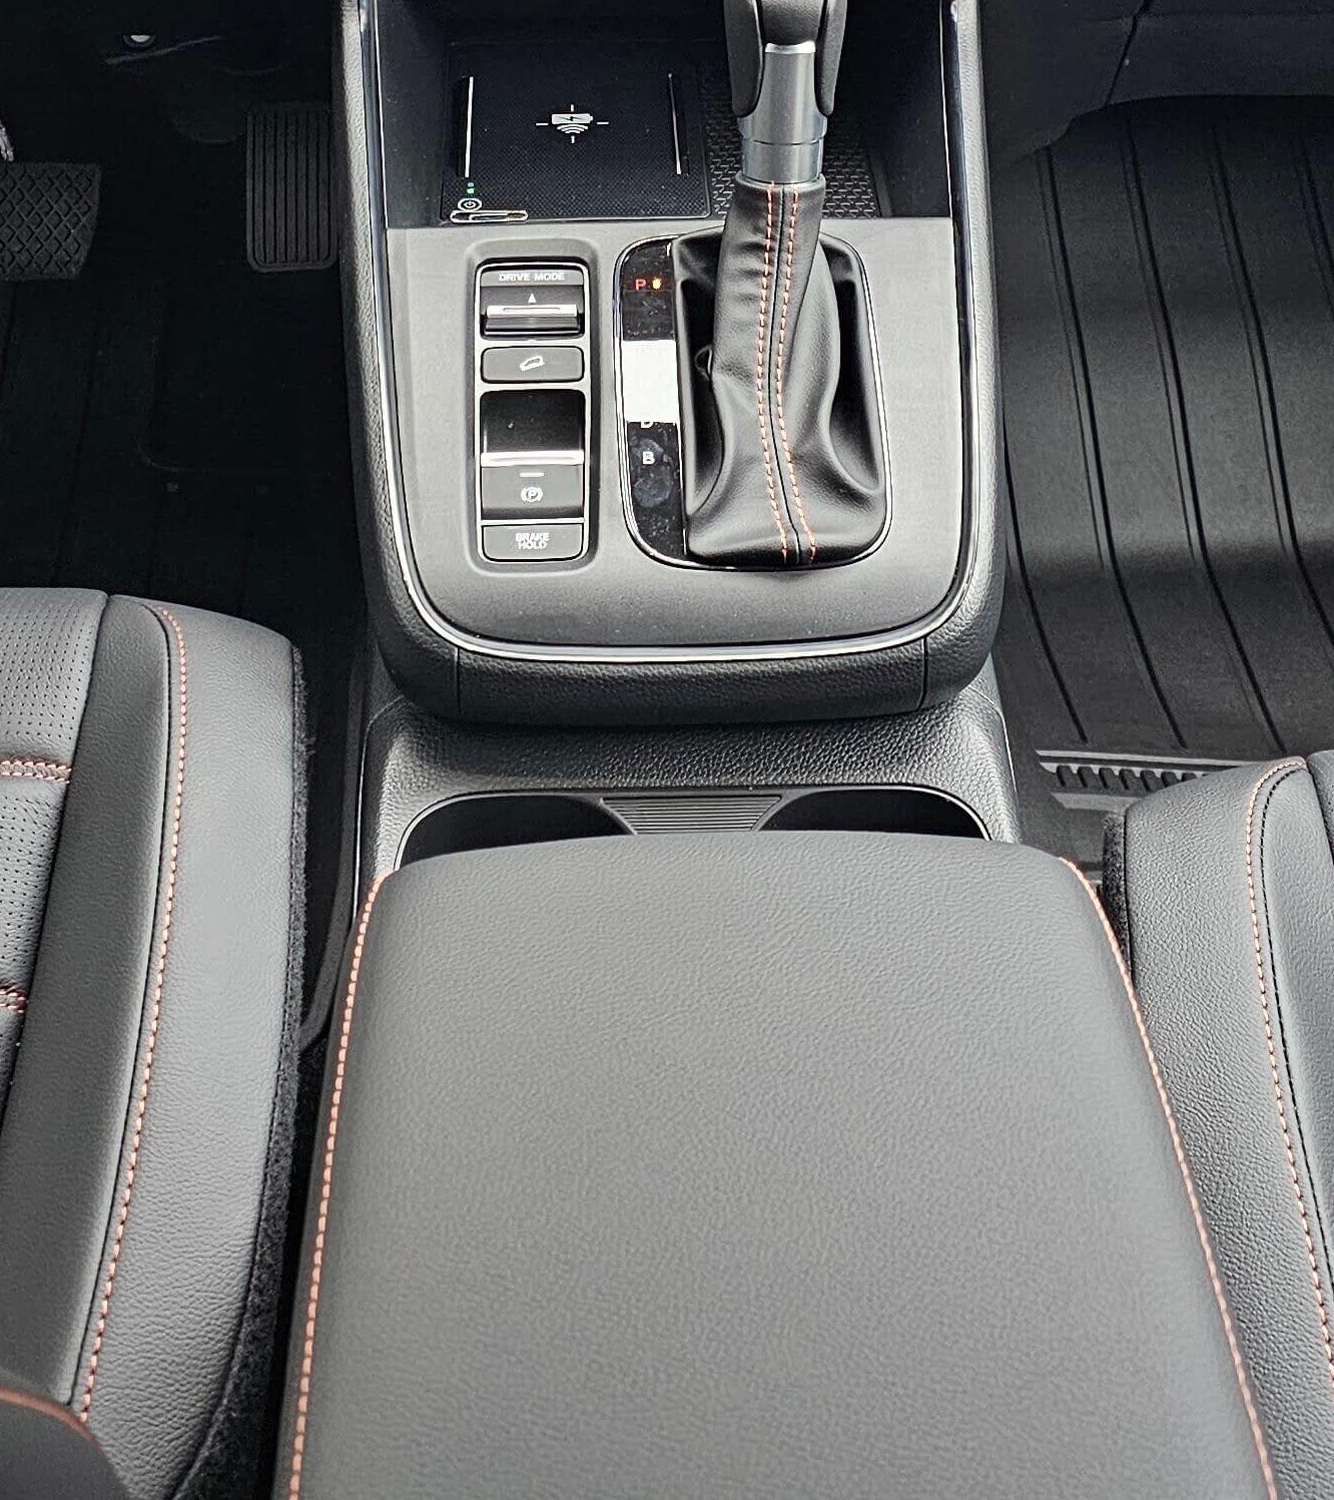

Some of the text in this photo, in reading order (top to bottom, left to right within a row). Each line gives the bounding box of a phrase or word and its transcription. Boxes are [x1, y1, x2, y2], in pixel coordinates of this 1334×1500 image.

[499, 272, 565, 281] DRIVE MODE
[635, 279, 646, 290] P
[642, 451, 655, 465] B
[515, 532, 549, 542] BRAKE
[518, 540, 548, 550] HOLD
